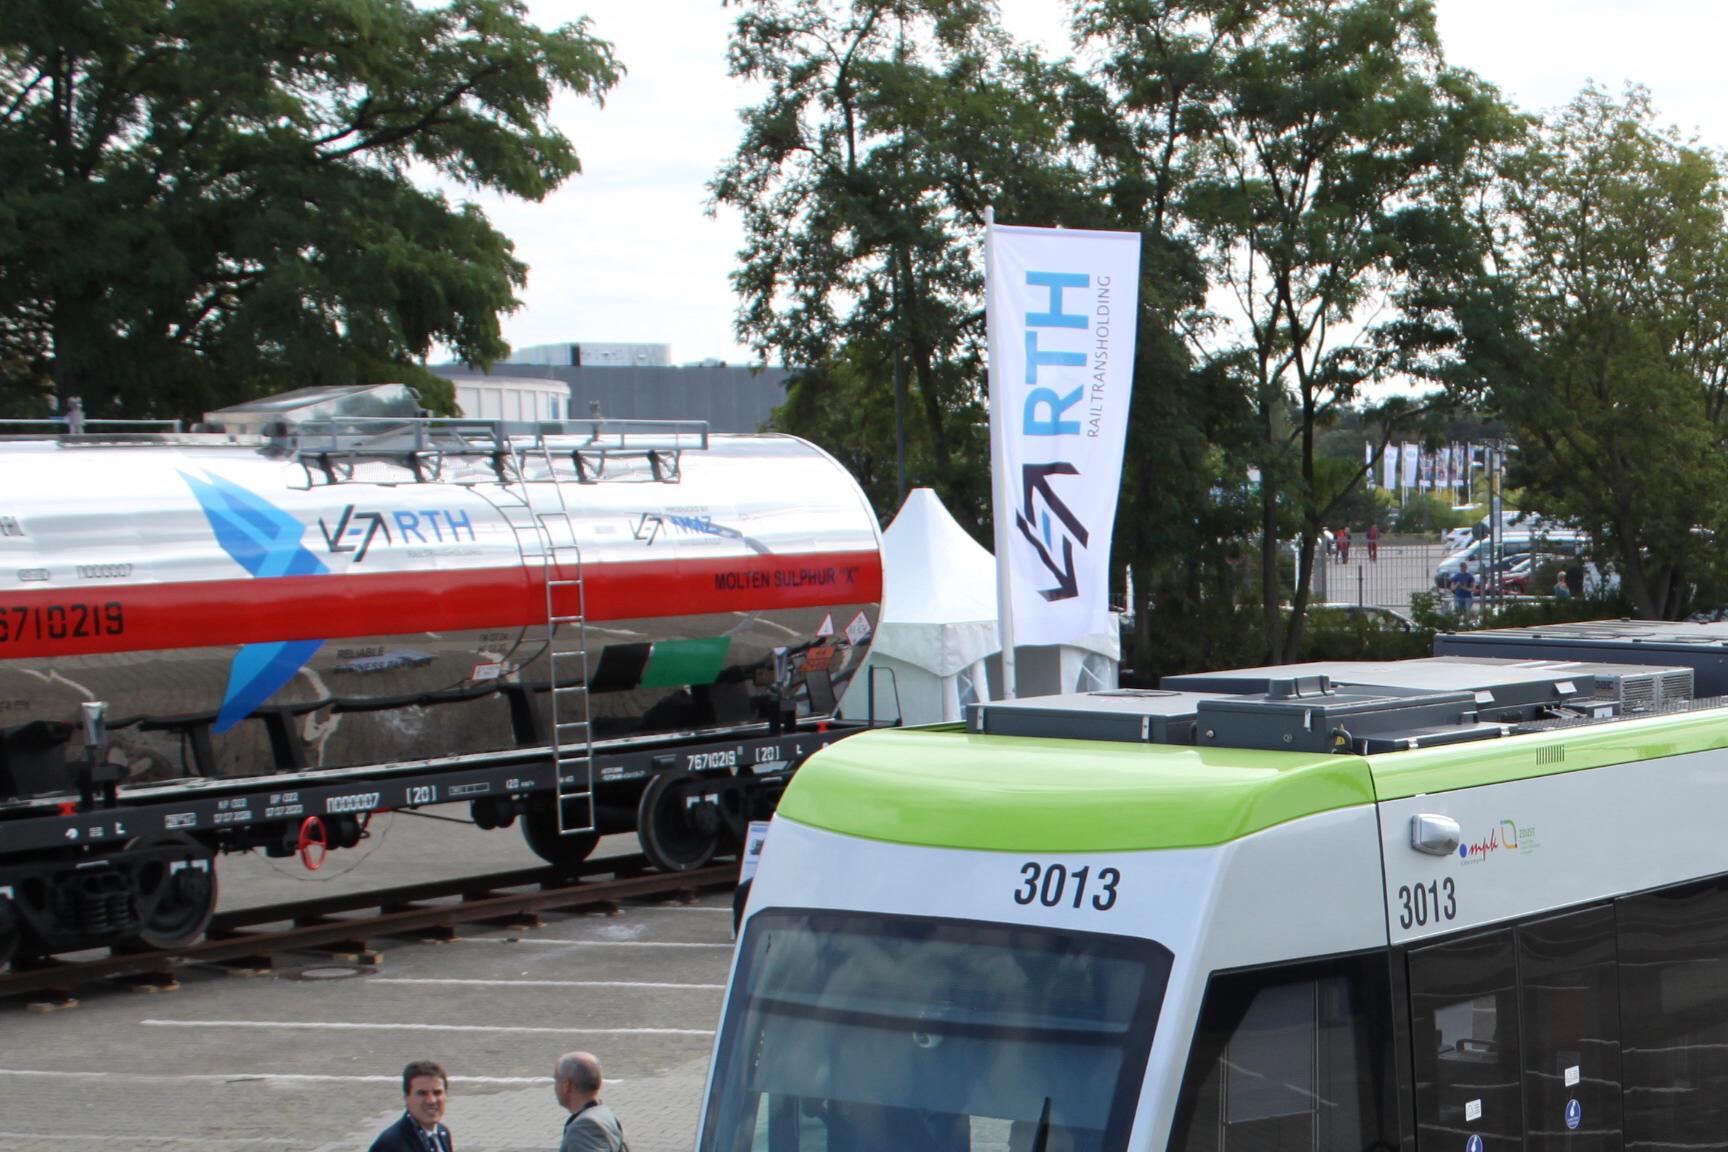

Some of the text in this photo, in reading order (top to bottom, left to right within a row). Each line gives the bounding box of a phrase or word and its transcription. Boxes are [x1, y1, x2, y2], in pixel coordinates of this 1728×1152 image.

[1022, 271, 1090, 437] RTH
[1087, 275, 1111, 438] RAILTRANSHOLDING
[392, 509, 476, 544] RTH
[715, 571, 770, 590] MOLTEN
[774, 567, 835, 586] SULPHUR
[1014, 861, 1121, 911] 3013
[1399, 877, 1457, 930] 3013
